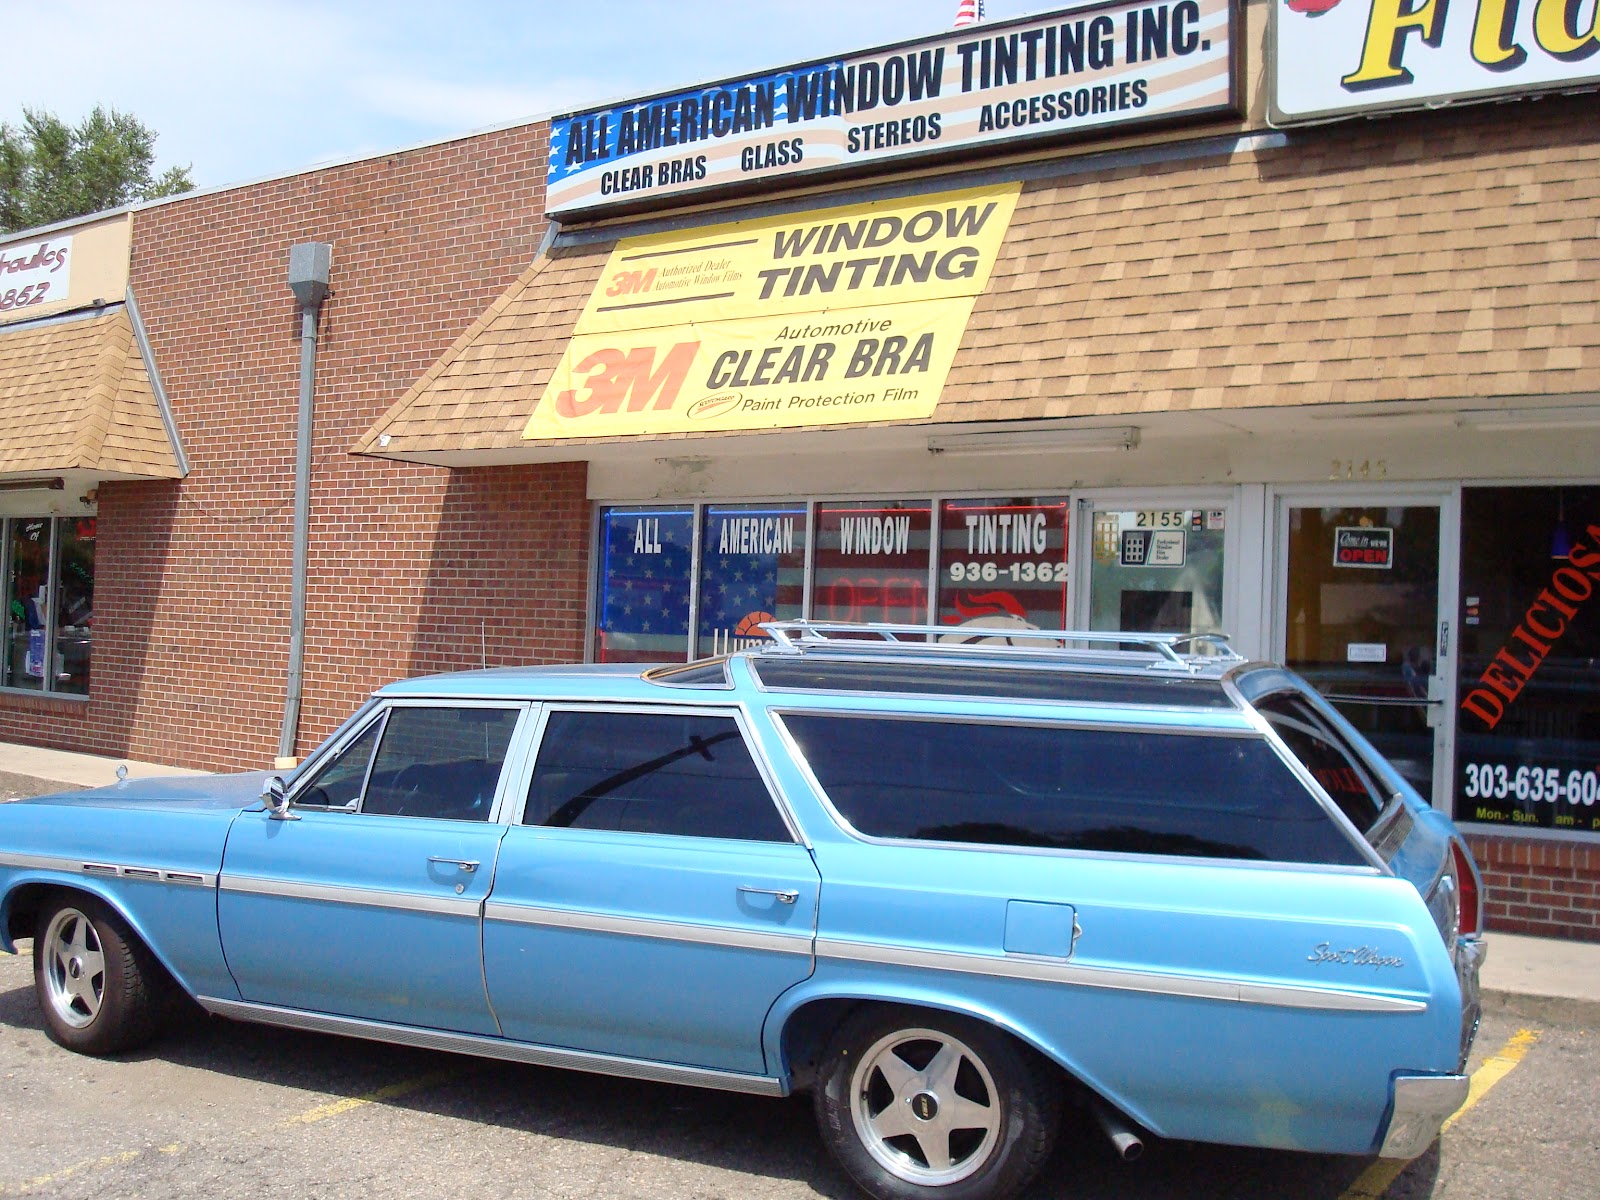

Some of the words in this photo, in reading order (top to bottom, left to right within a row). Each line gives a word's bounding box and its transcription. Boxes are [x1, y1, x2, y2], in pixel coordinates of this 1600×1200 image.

[564, 116, 612, 166] ALL
[616, 81, 776, 156] AMERICAN
[786, 47, 945, 124] WINDOW
[957, 15, 1115, 93] TINTING
[1126, 0, 1211, 64] INC.
[600, 163, 653, 196] CLEAR
[657, 155, 706, 187] BRAS
[741, 138, 804, 172] GLASS
[847, 112, 942, 153] STEREOS
[978, 79, 1148, 132] ACCESSORIES
[772, 202, 999, 259] WINDOW
[606, 268, 659, 297] 3M
[661, 261, 703, 278] Authorized
[704, 258, 731, 272] Dealer
[653, 277, 692, 291] Automotive
[694, 273, 721, 286] Window
[722, 270, 743, 282] Films
[756, 246, 980, 300] TINTING
[774, 317, 893, 342] Automotive
[555, 340, 701, 418] 3M
[706, 341, 836, 390] CLEAR
[843, 332, 935, 379] BRA
[741, 397, 785, 411] Paint
[788, 390, 878, 409] Protection
[883, 386, 919, 403] Film
[634, 518, 662, 554] ALL
[719, 517, 794, 554] AMERICAN
[840, 516, 910, 555] WINDOW
[966, 513, 1047, 554] TINTING
[1137, 512, 1183, 527] 2155
[950, 562, 1069, 583] 936-1362
[1341, 548, 1388, 563] OPEN
[1460, 524, 1600, 730] DELICIOS
[1512, 810, 1539, 823] Sun.
[1556, 814, 1574, 826] am
